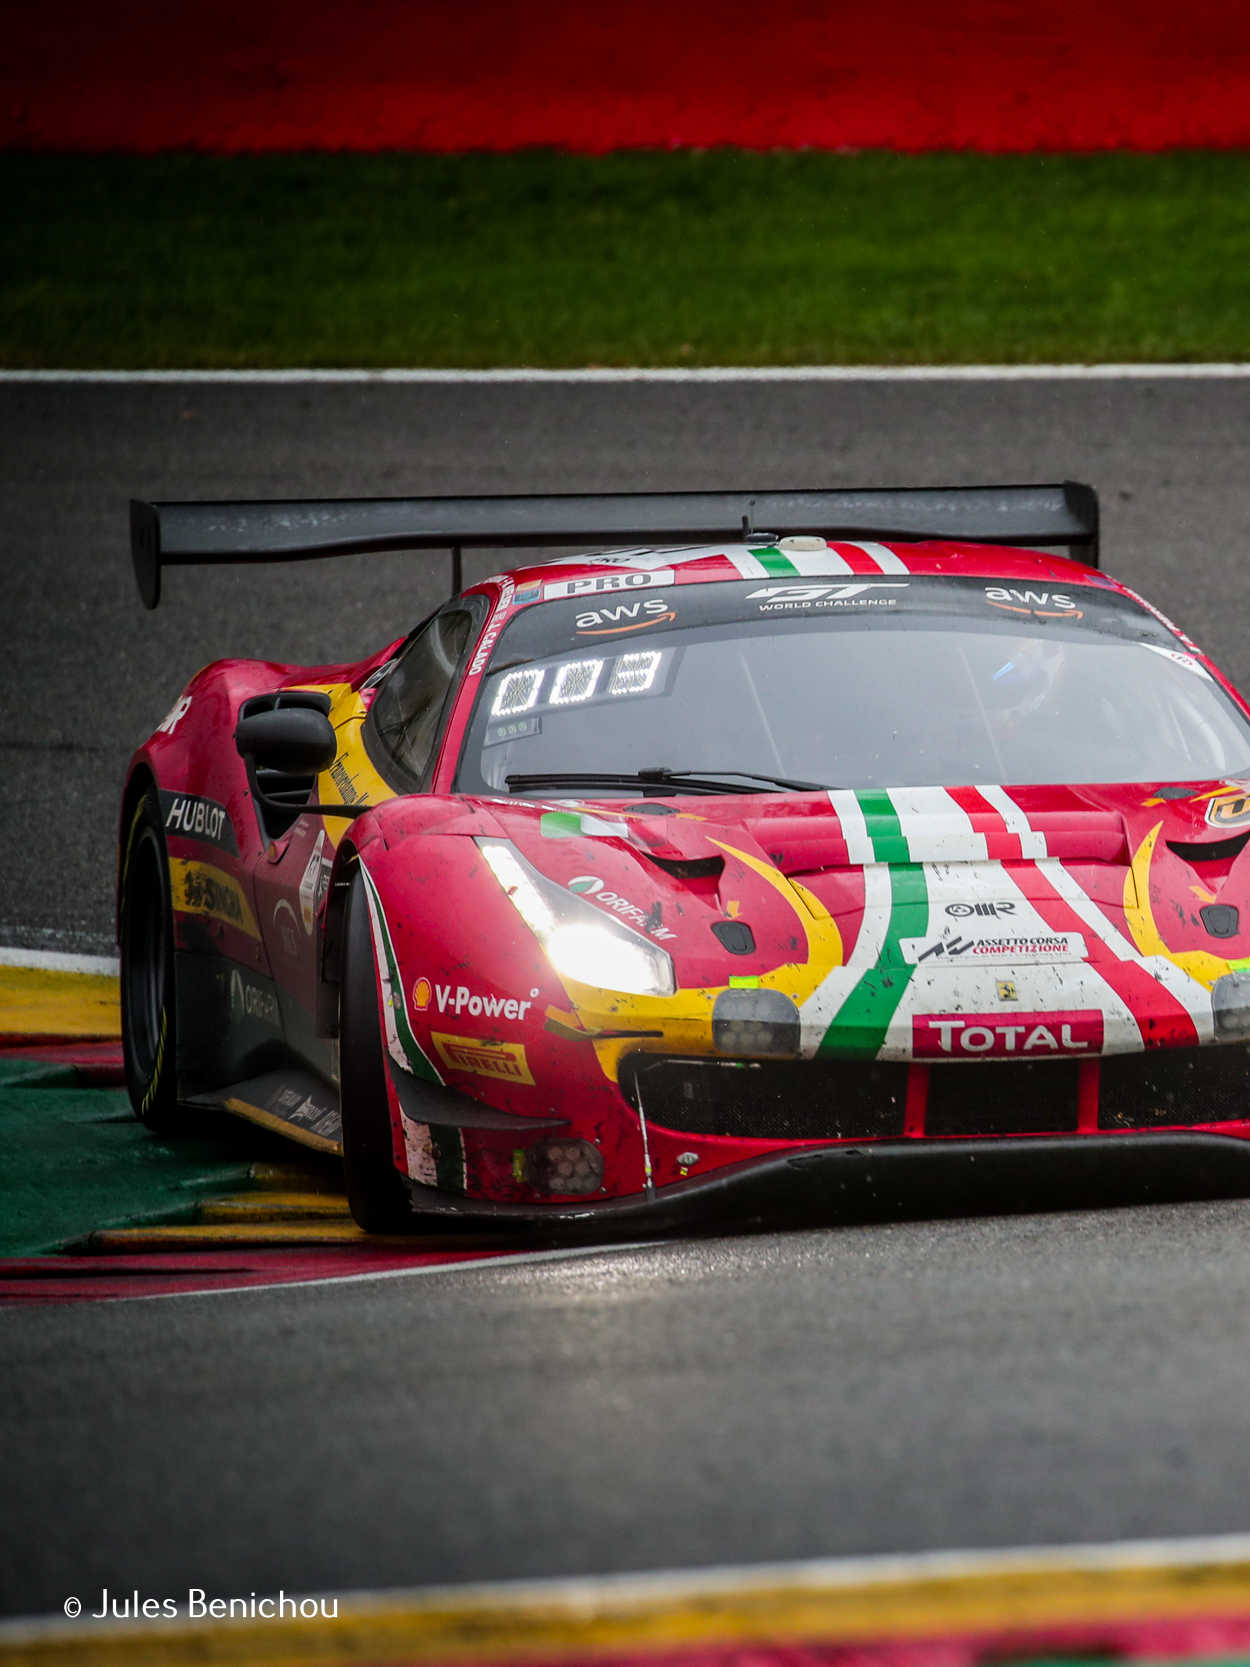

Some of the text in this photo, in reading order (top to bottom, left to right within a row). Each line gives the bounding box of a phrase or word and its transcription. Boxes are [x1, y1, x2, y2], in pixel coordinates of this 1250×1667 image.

[566, 574, 652, 594] PRO
[759, 599, 897, 611] WORLD CHALLENGE
[984, 587, 1077, 609] aws
[575, 599, 669, 628] aws
[165, 798, 226, 841] HUBLOT
[973, 944, 1069, 955] COMPETIZIONE
[977, 937, 1069, 947] ASSETTO CORSA
[435, 984, 531, 1021] V-Power
[928, 1020, 1088, 1052] TOTAL
